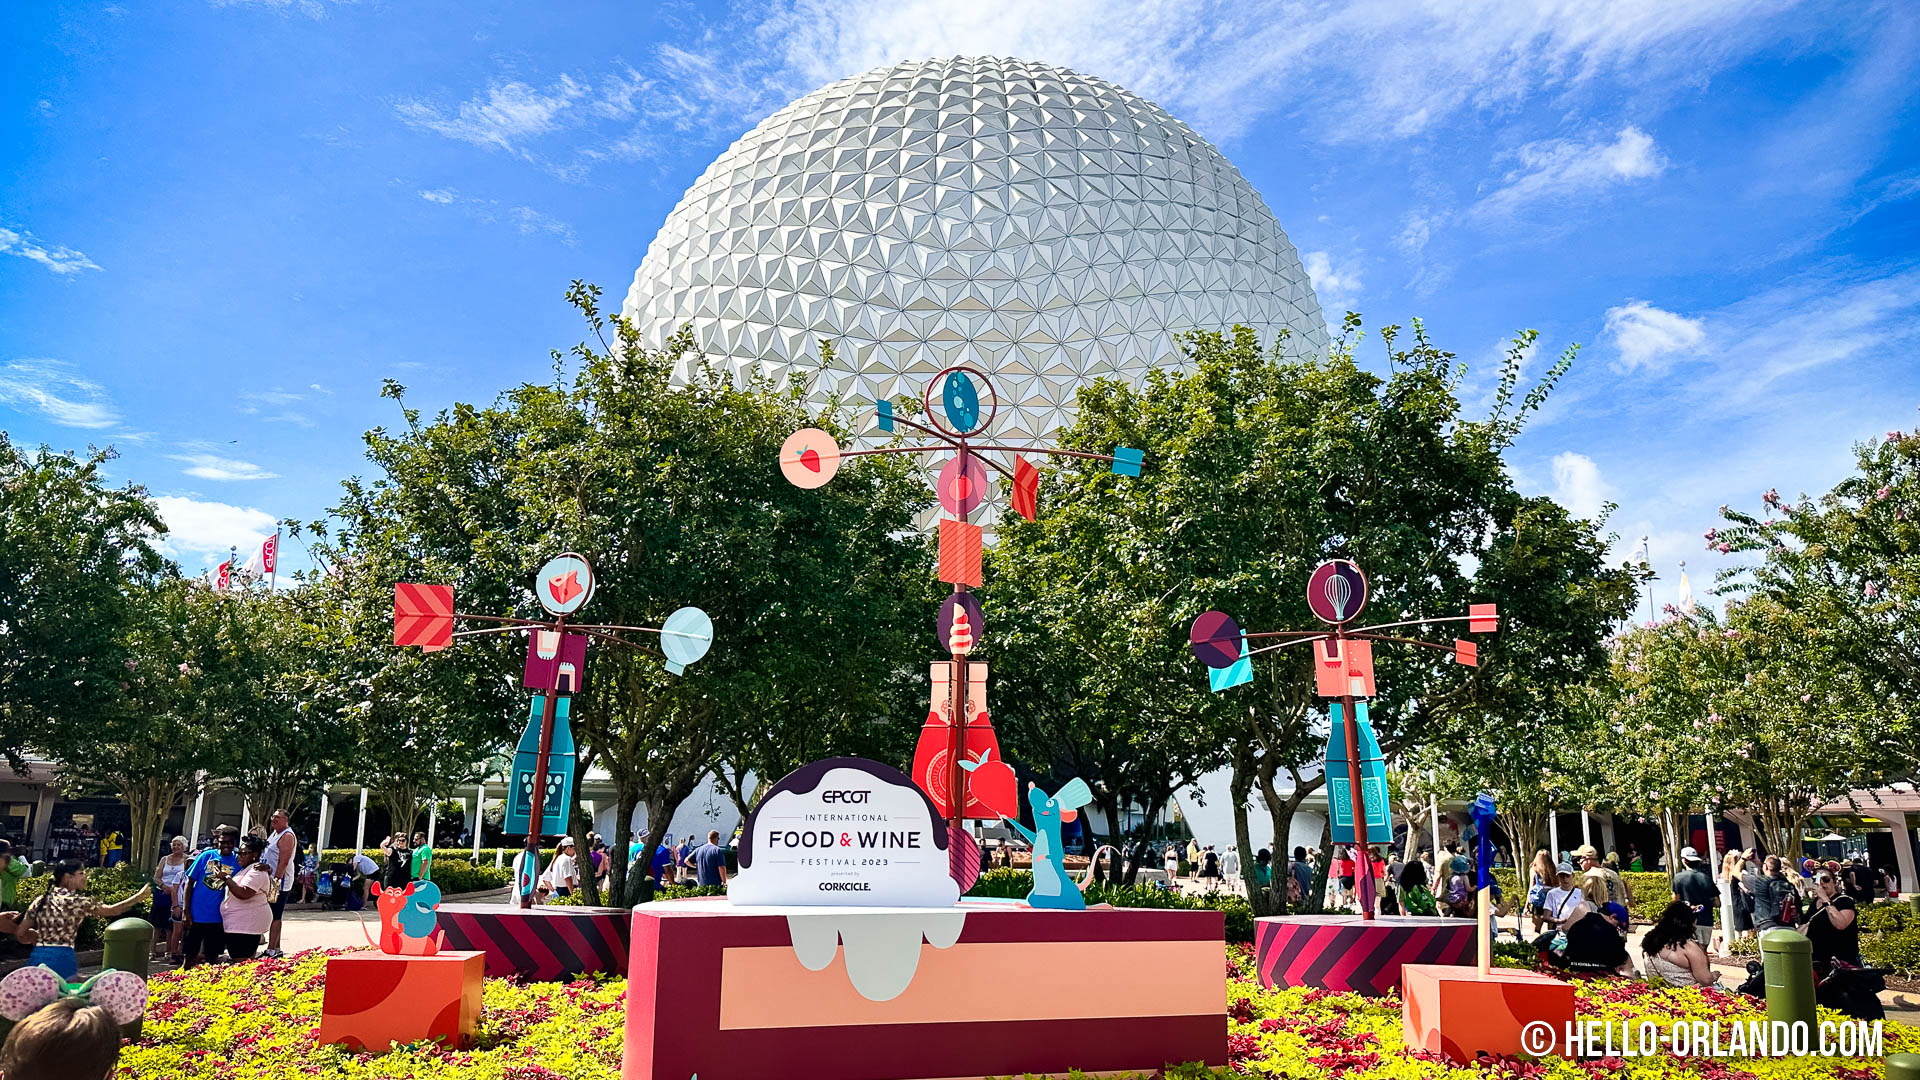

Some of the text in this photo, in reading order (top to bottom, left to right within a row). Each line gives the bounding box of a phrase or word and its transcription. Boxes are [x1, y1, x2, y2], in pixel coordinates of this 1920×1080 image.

[822, 790, 871, 804] EPCOT
[1336, 781, 1346, 813] DOWD
[1371, 781, 1380, 813] DOWD
[805, 814, 888, 822] INTERNATIONAL
[769, 831, 921, 849] FOOD & WINE
[801, 858, 889, 866] FESTIVAL 2023
[819, 882, 871, 891] CORKCICLE.
